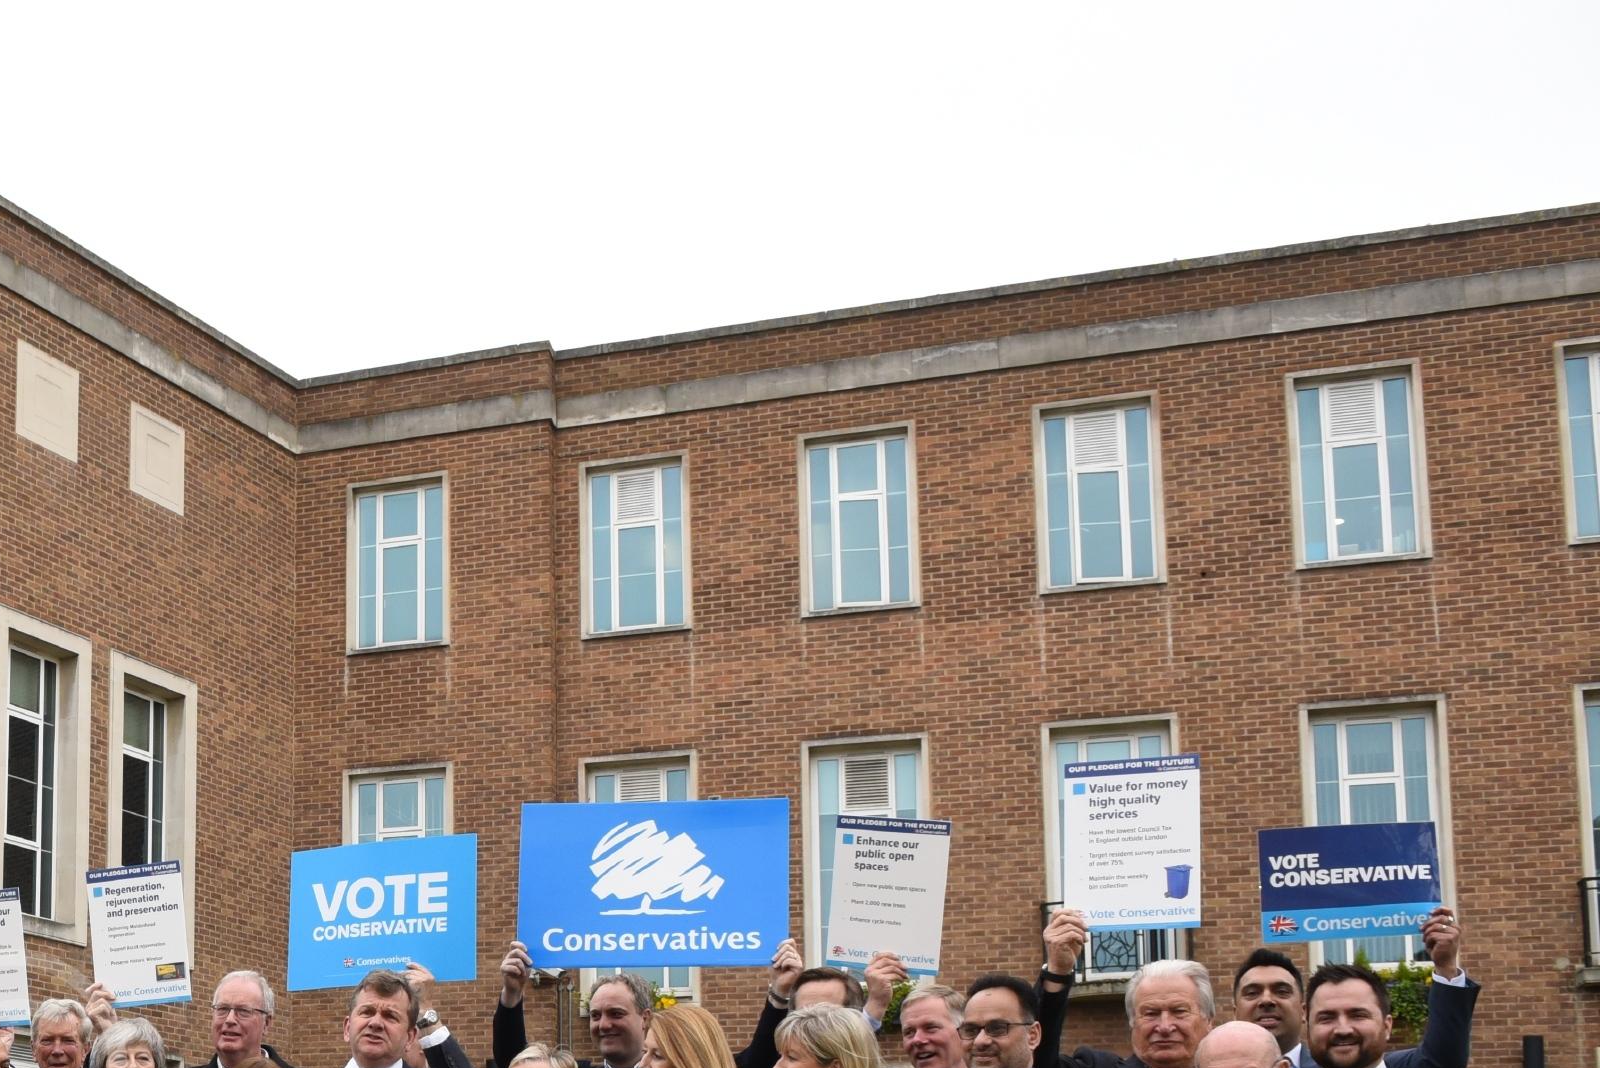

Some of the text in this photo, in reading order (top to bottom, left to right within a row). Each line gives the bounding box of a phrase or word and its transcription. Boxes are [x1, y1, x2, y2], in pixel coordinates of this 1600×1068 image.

[1089, 780, 1188, 794] Value for money
[1089, 793, 1161, 809] high quality
[1089, 809, 1138, 821] services
[856, 836, 920, 849] Enhance our
[855, 849, 914, 862] public open
[1269, 853, 1319, 870] VOTE
[854, 862, 889, 872] spaces
[1270, 865, 1432, 887] CONSERVATIVE
[105, 882, 165, 896] Regeneration,
[312, 872, 448, 921] VOTE
[106, 894, 160, 908] rejuvenation
[107, 902, 179, 918] and preservation
[313, 917, 447, 942] CONSERVATIVE
[1304, 912, 1426, 932] Conservative
[542, 927, 761, 952] Conservatives
[357, 956, 411, 966] Conservatives
